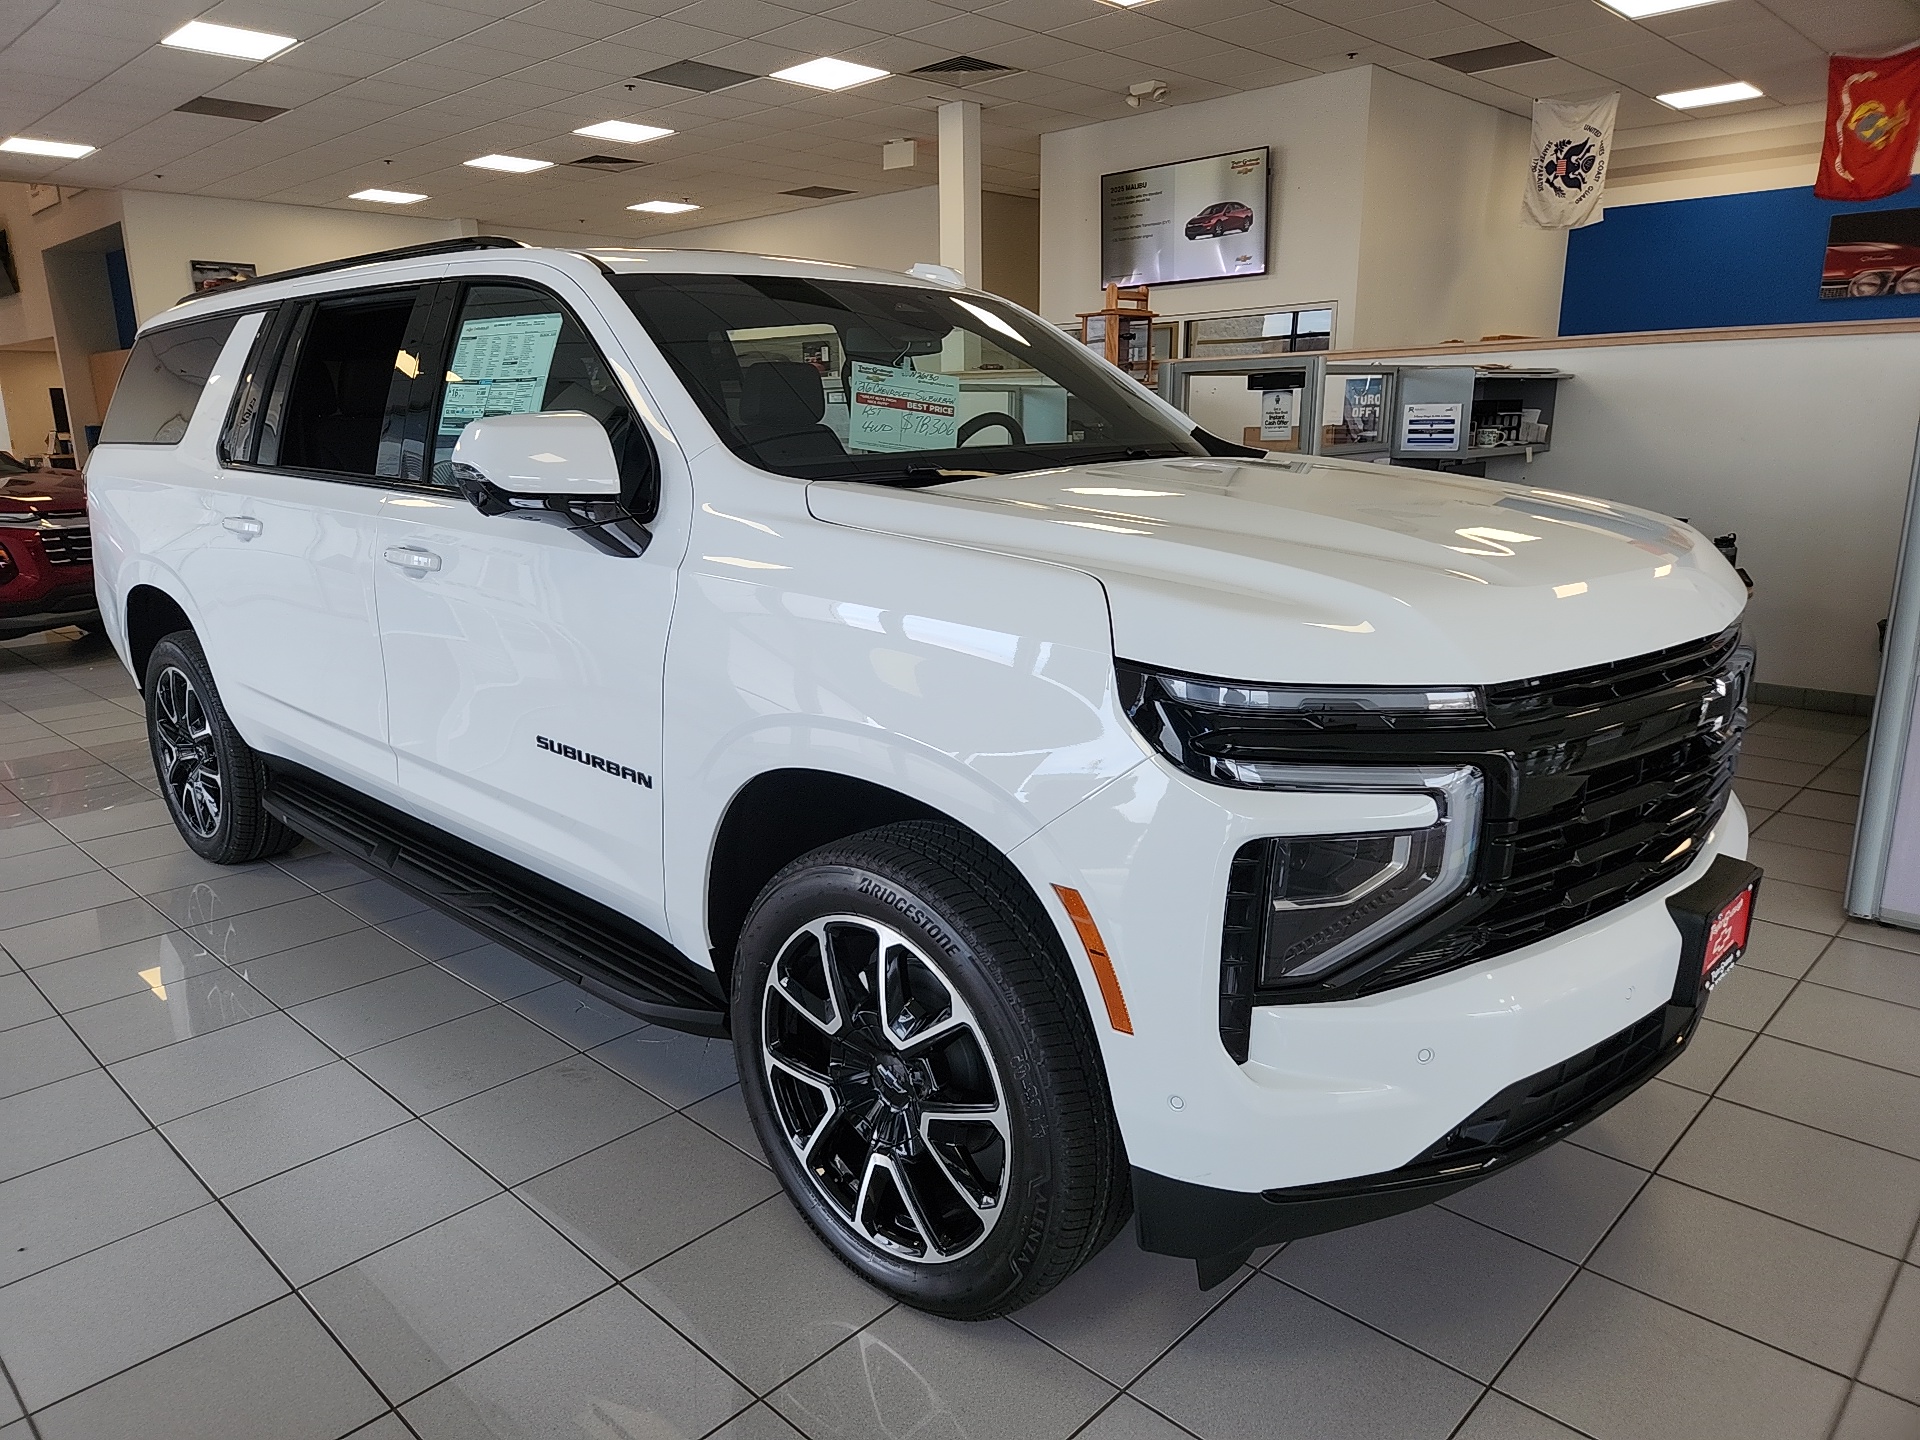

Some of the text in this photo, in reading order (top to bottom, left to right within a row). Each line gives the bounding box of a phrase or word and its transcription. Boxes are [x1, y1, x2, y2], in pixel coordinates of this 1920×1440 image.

[1583, 124, 1602, 137] UNITED
[1594, 160, 1605, 182] COAST
[1125, 182, 1147, 191] MALIBU
[1575, 185, 1594, 204] GUARD
[872, 383, 914, 397] CHEVROLET
[915, 390, 957, 405] SUBURBAN
[906, 402, 954, 415] BEST PRICE
[1352, 406, 1372, 418] OFF
[862, 420, 894, 433] 4WD
[901, 412, 955, 436] $78,306
[535, 735, 653, 789] SUBURBAN
[857, 877, 961, 958] BRIDGESTONE
